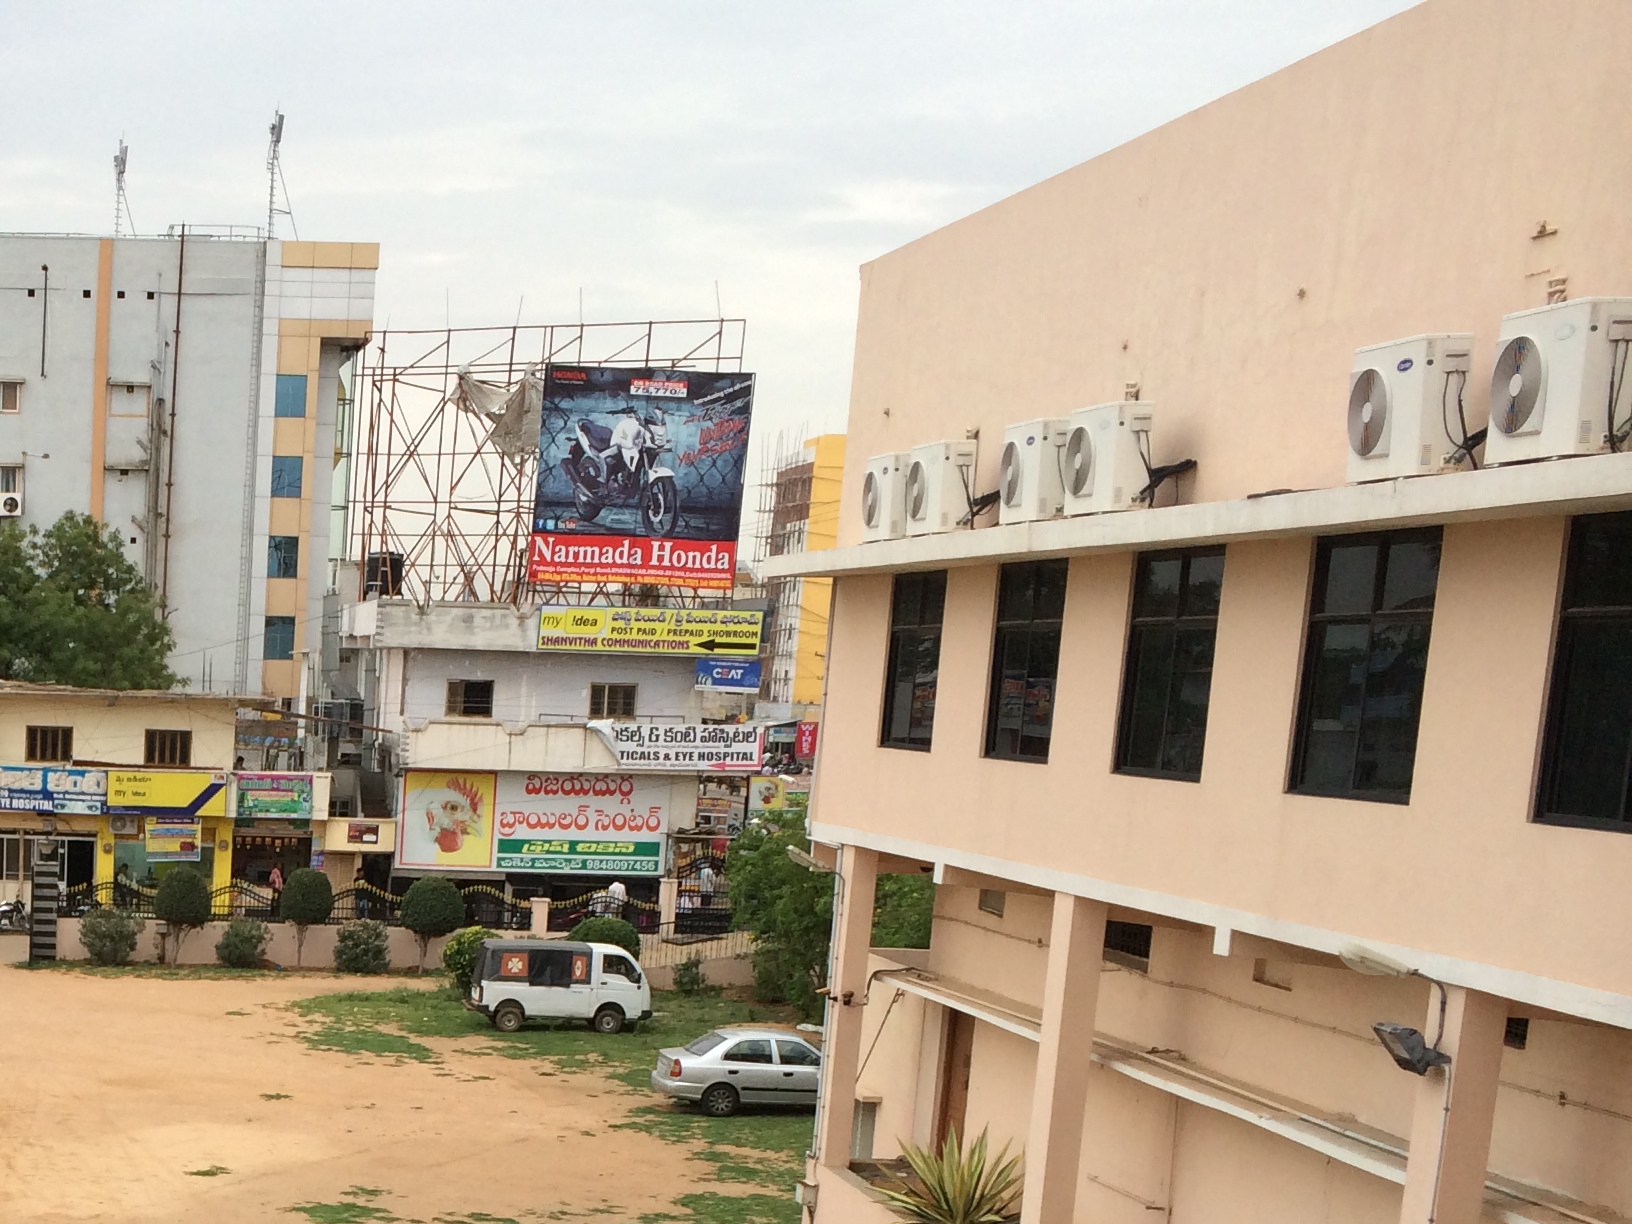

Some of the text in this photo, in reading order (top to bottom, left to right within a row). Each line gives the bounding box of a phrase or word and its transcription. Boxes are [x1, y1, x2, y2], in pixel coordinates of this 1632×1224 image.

[532, 536, 730, 570] Narmada Honda
[542, 615, 563, 628] my
[611, 626, 634, 635] POST
[637, 627, 657, 636] PAID
[667, 628, 704, 637] PREPAID
[707, 629, 758, 639] SHOWROOM
[541, 635, 690, 650] SHANVITHA COMMUNICATIONS
[712, 668, 744, 679] CEAT
[674, 751, 695, 761] EYE
[697, 751, 755, 762] HOSPITAL
[524, 774, 634, 805] విజయదుర్గ
[12, 799, 54, 811] HOSPITAL
[594, 806, 662, 832] సెంటర్
[586, 860, 656, 871] 9848097456
